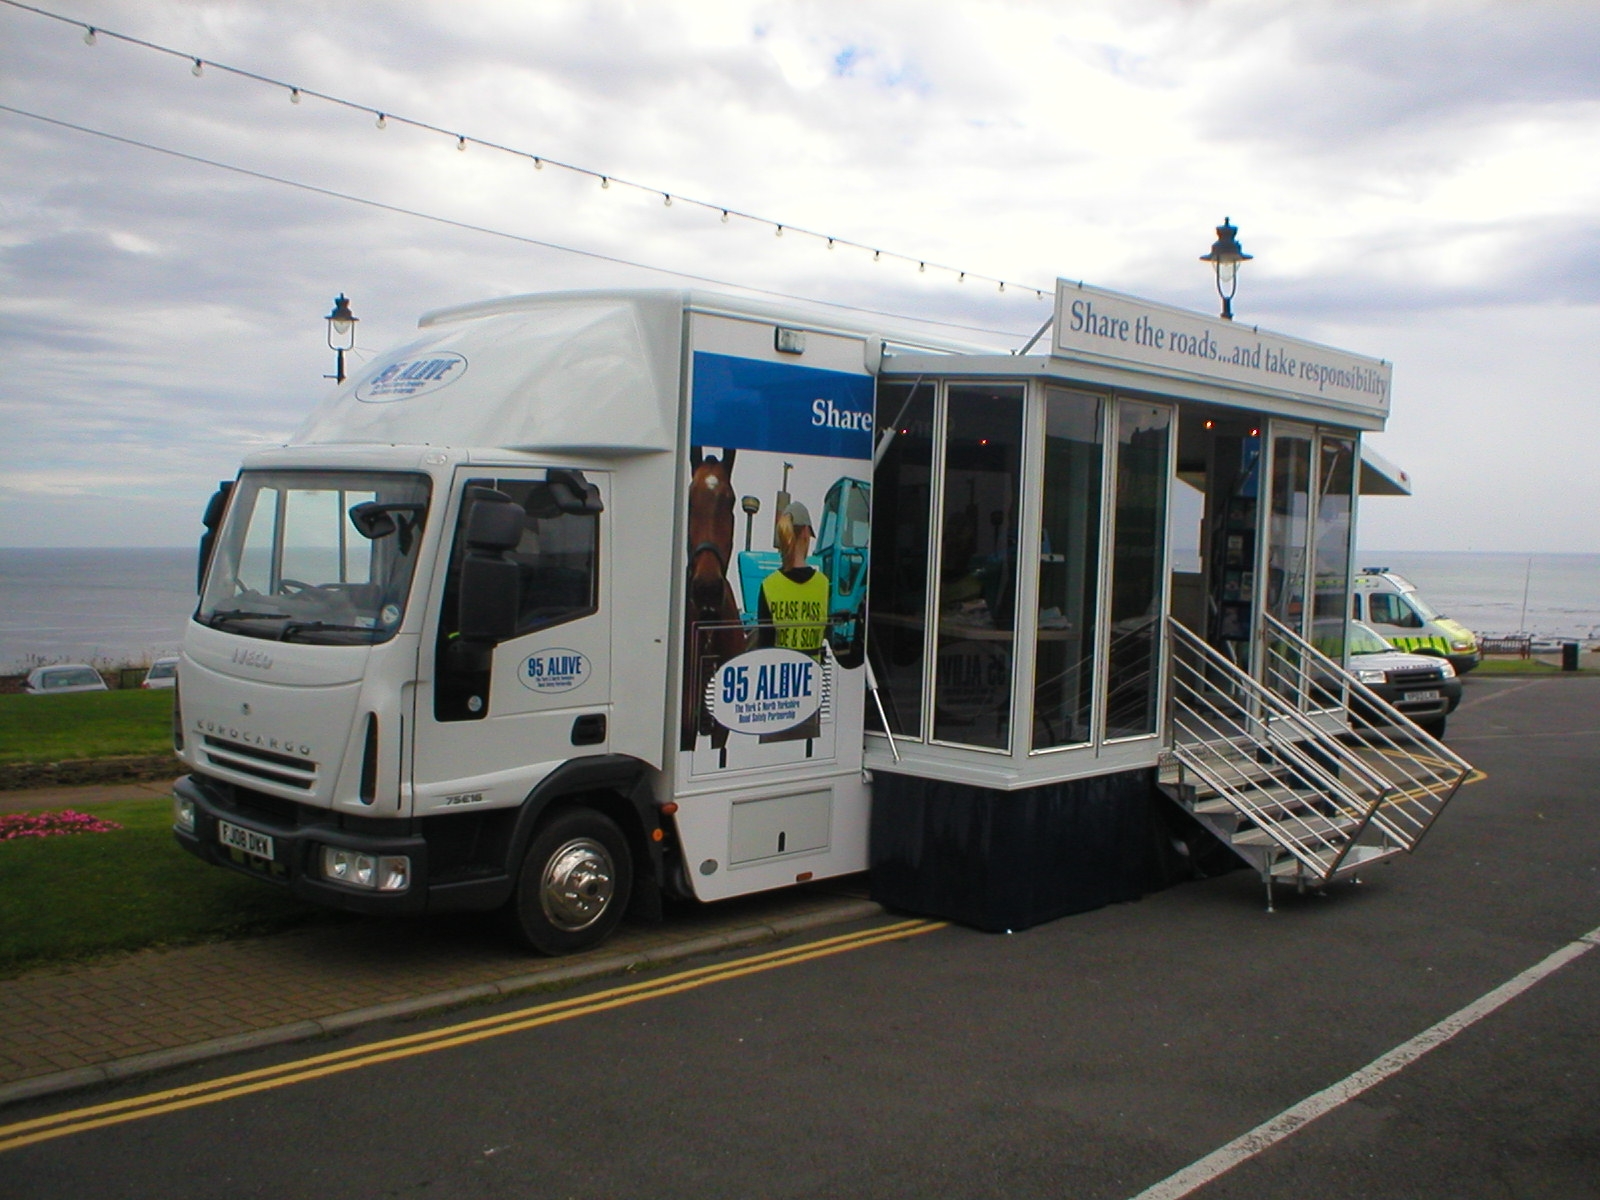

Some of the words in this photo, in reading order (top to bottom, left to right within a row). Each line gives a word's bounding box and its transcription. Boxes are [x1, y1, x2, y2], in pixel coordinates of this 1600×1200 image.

[1070, 300, 1129, 341] Share
[1135, 314, 1174, 349] the
[1265, 347, 1296, 377] take
[1299, 360, 1388, 403] responsibility
[811, 399, 872, 432] Share
[771, 600, 798, 620] PLEASE
[801, 601, 820, 621] PASS
[528, 658, 544, 677] 95
[722, 665, 748, 703] 95
[756, 662, 813, 700] ALIVE
